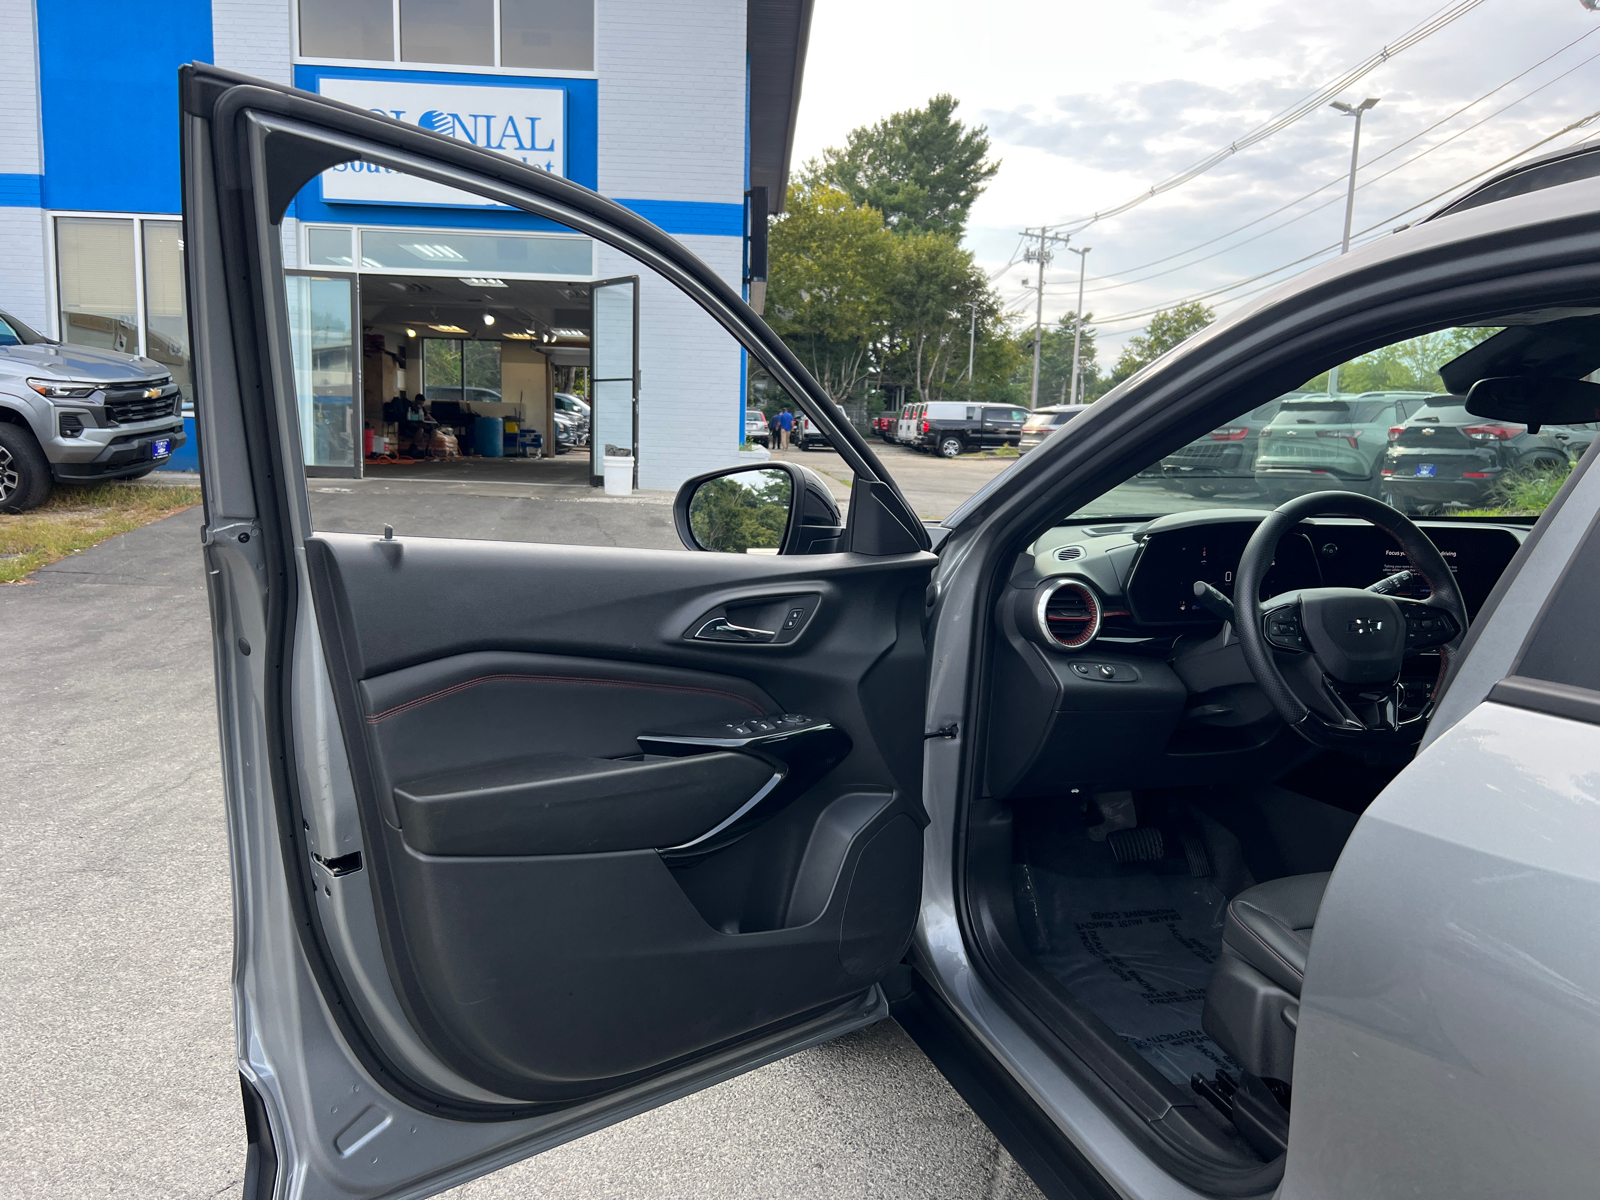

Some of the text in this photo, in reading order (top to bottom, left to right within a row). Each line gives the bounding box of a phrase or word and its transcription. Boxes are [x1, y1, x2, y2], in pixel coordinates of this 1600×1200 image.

[369, 109, 555, 152] ONIAL
[1074, 913, 1182, 931] DEALER MUST REMOVE
[1090, 910, 1121, 921] COVER
[1147, 994, 1206, 1005] PROTECTIV
